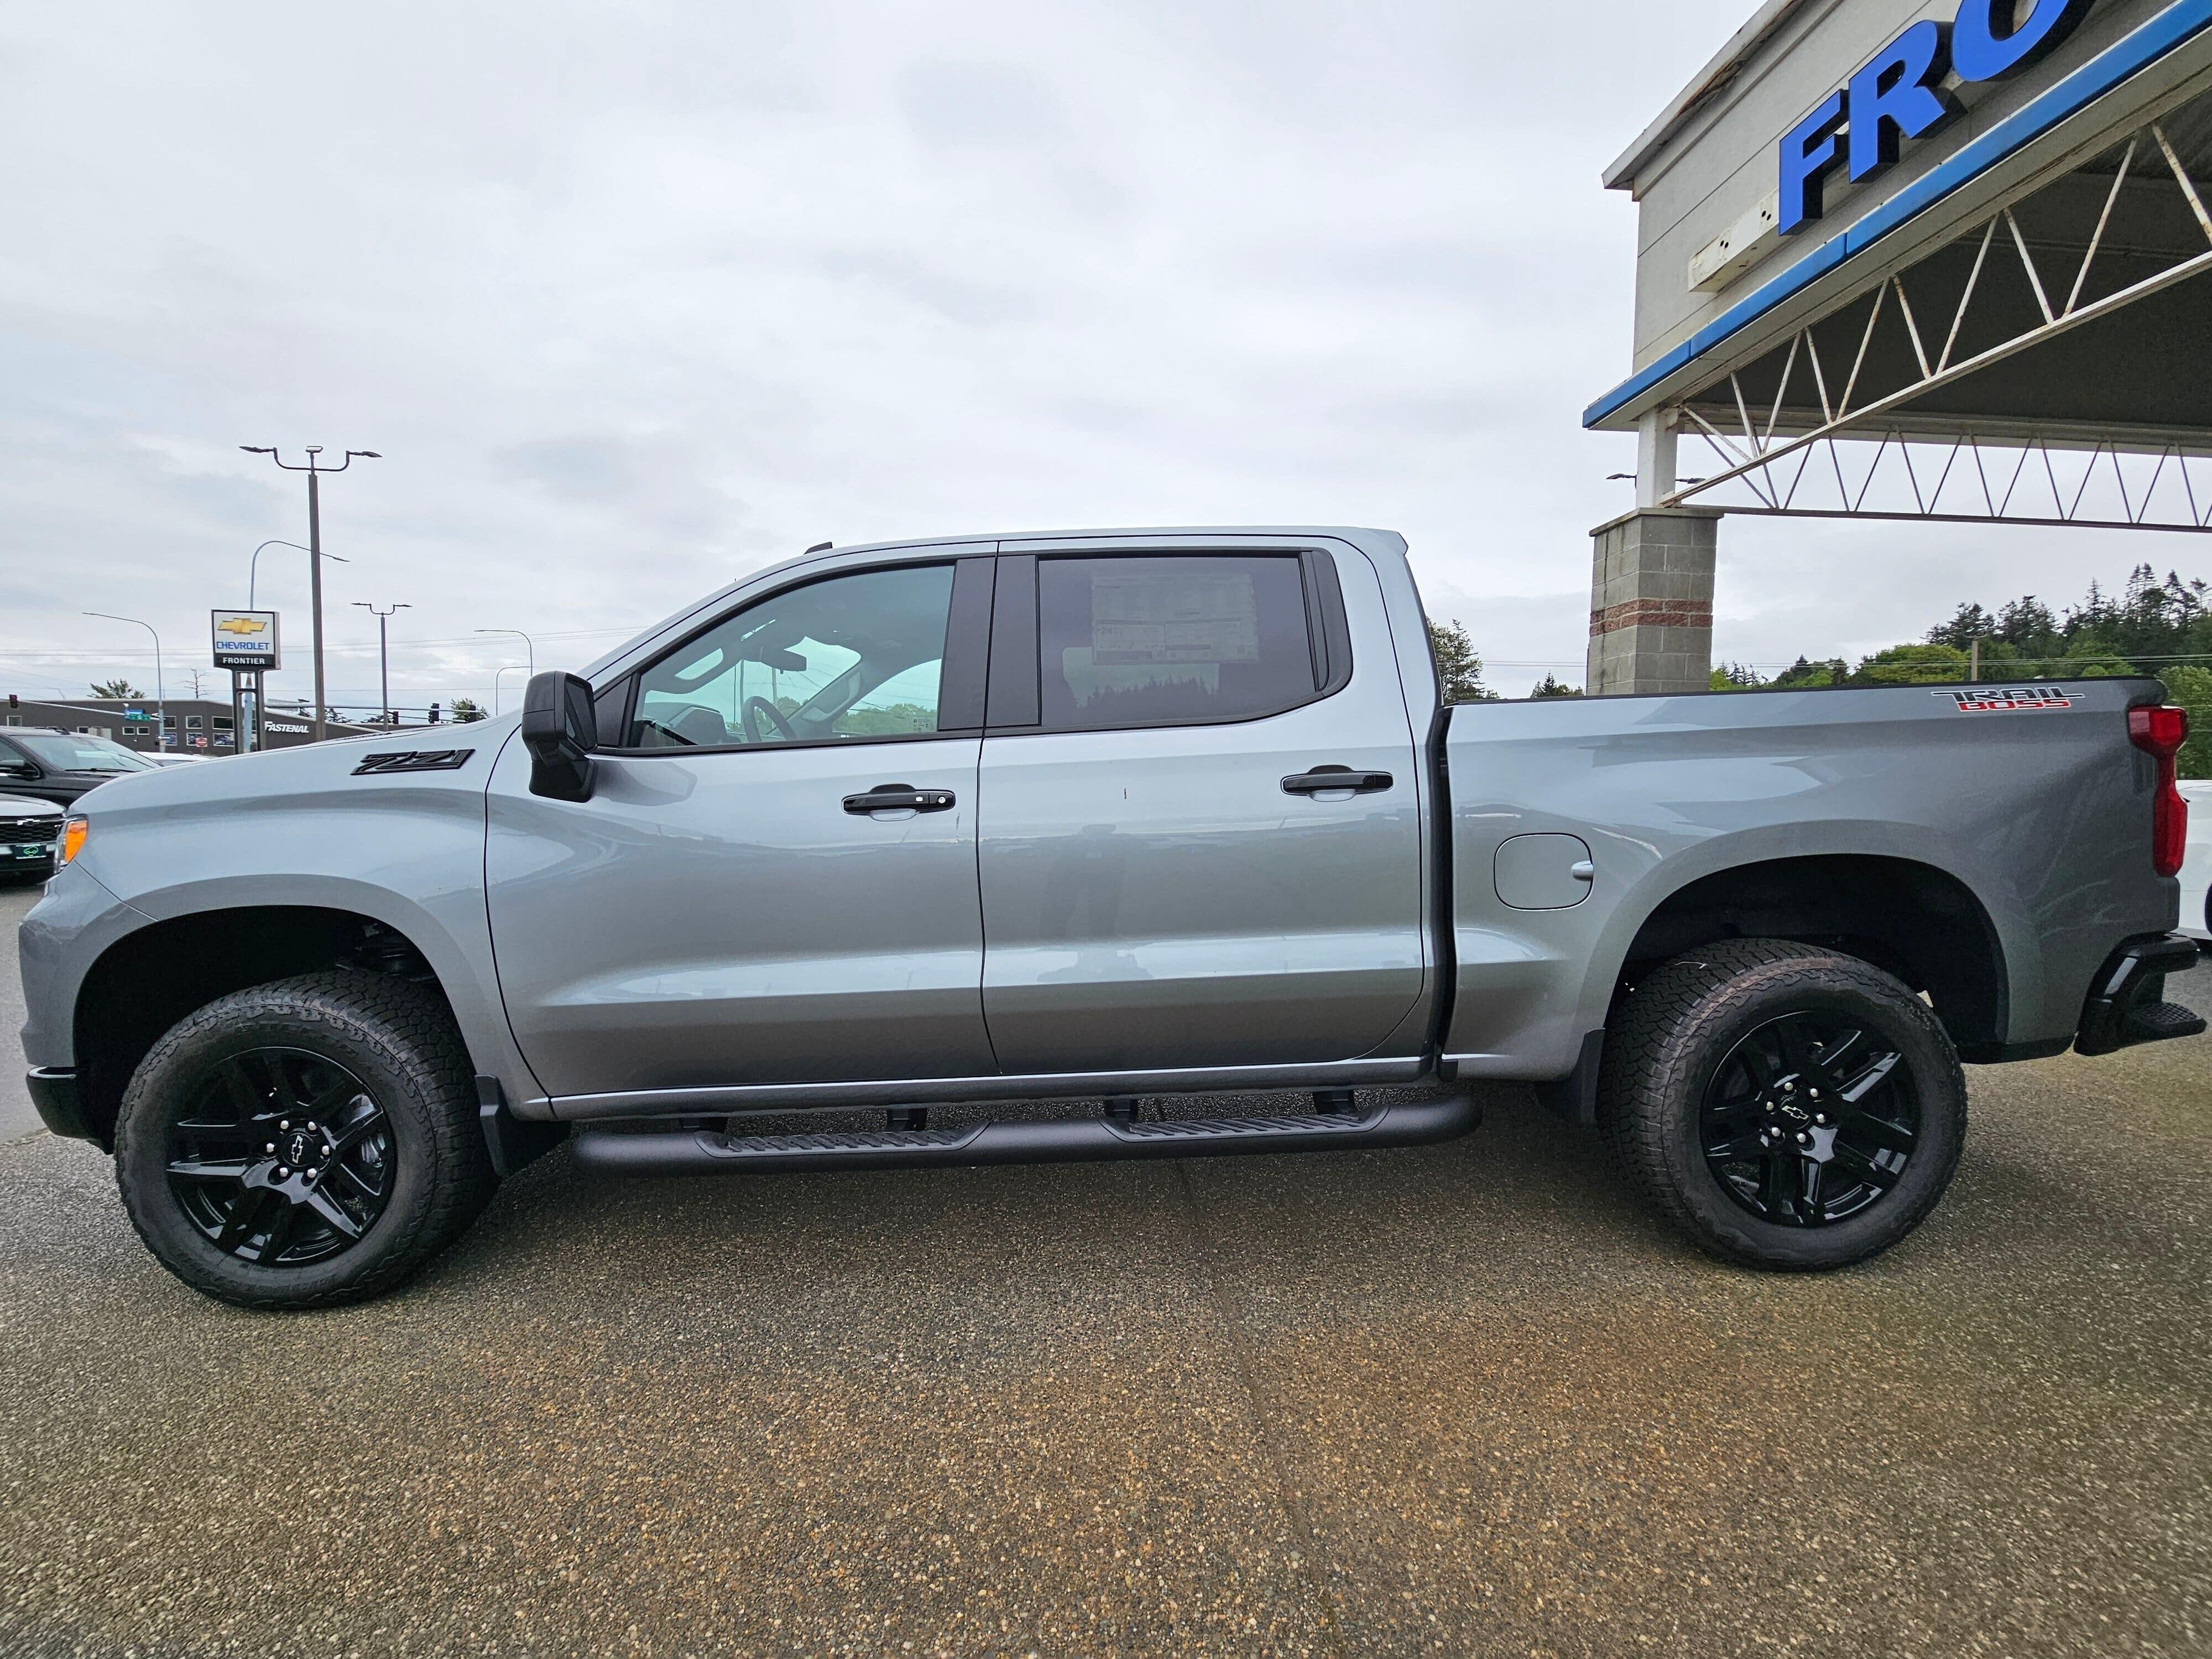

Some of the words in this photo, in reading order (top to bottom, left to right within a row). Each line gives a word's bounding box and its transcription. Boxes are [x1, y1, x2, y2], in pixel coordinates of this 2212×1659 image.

[216, 641, 270, 650] CHEVROLET
[1930, 687, 2085, 703] TRAIL
[1958, 698, 2072, 712] BOSS
[264, 721, 310, 733] FASTENAL
[349, 749, 476, 776] Z71
